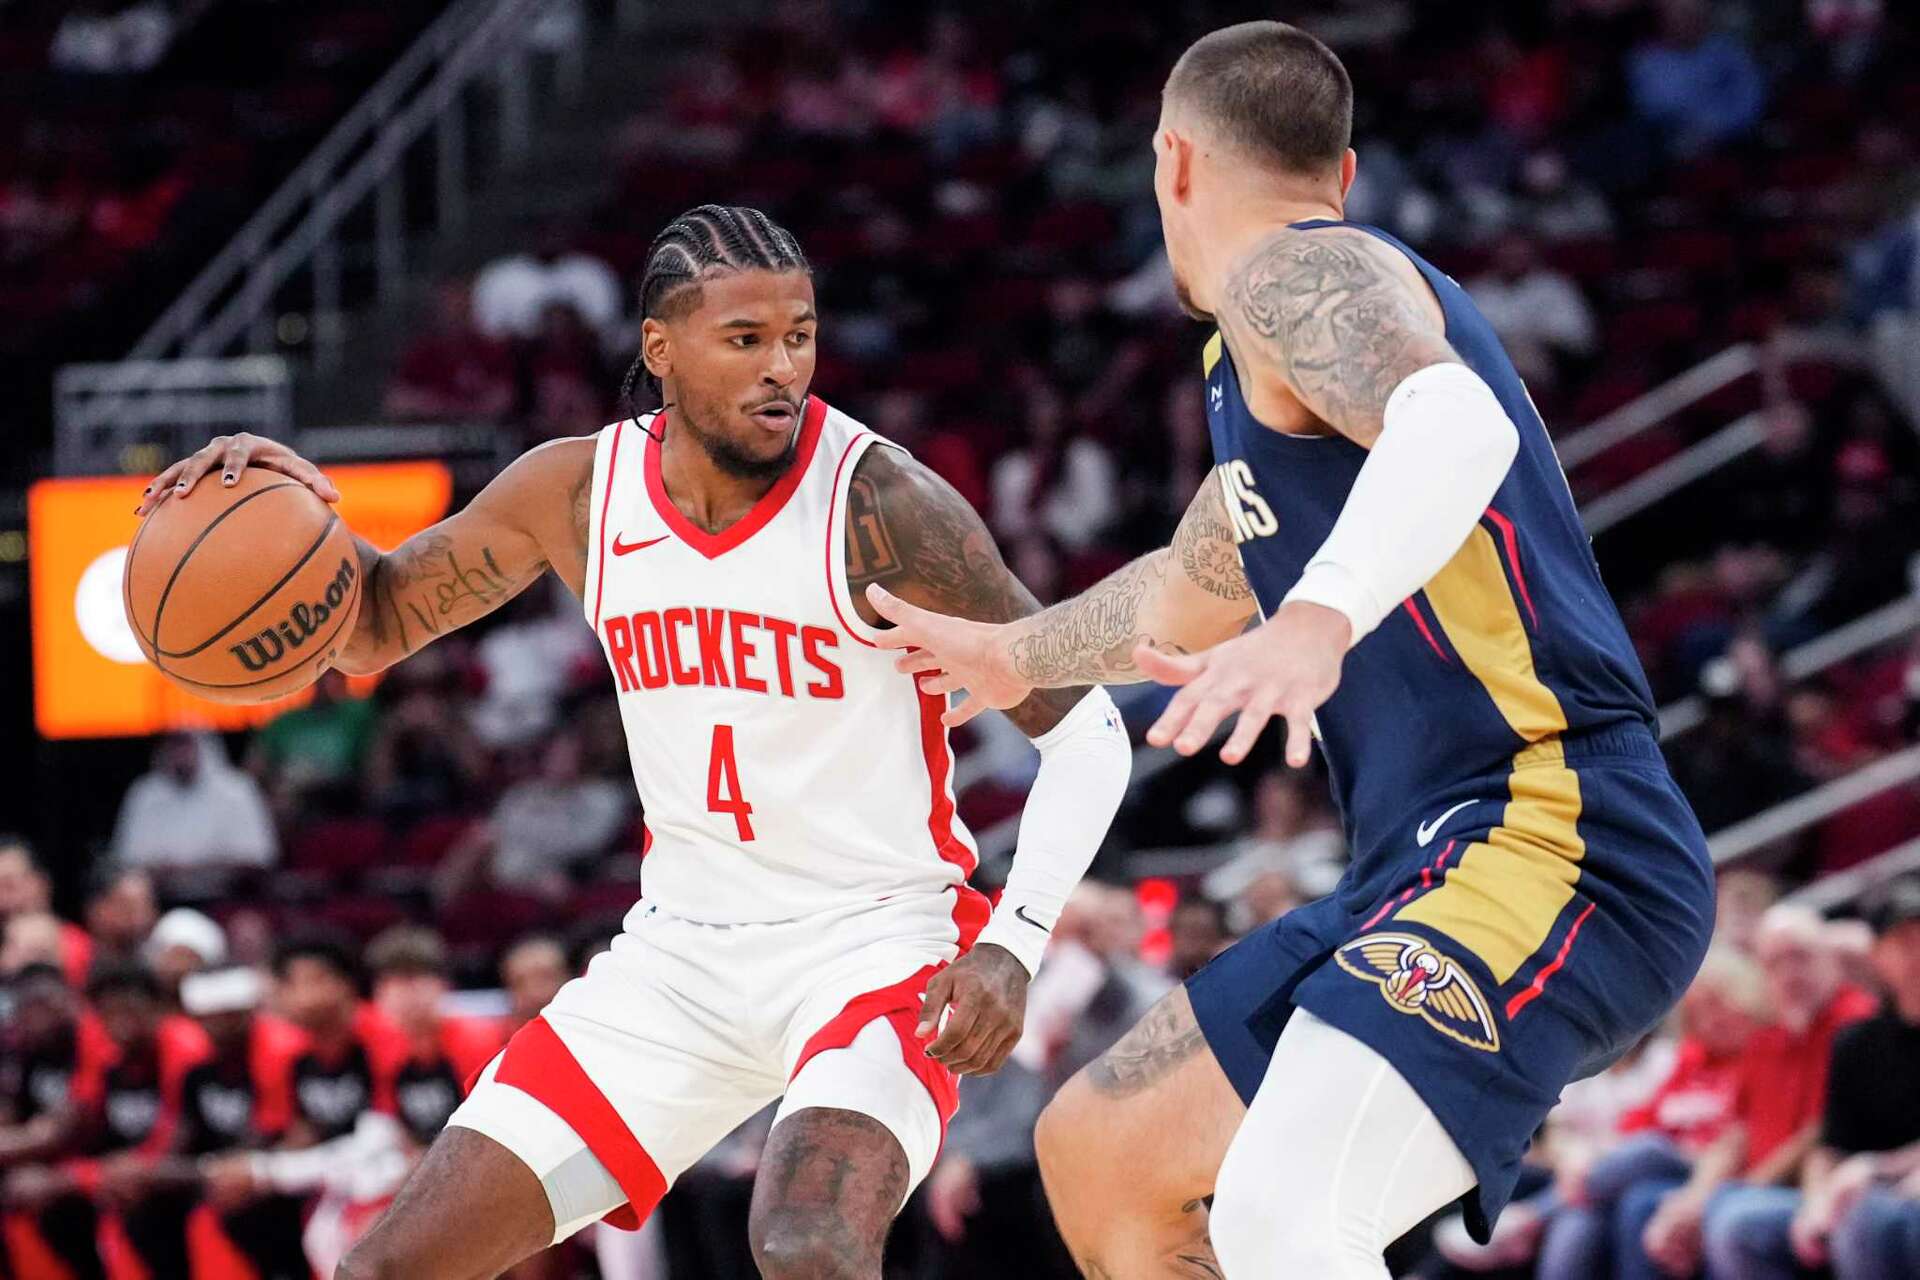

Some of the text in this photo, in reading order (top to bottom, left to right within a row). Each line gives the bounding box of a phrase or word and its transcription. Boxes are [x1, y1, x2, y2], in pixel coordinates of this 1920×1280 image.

[229, 557, 355, 672] Wilson
[603, 606, 845, 699] ROCKETS
[706, 724, 755, 842] 4
